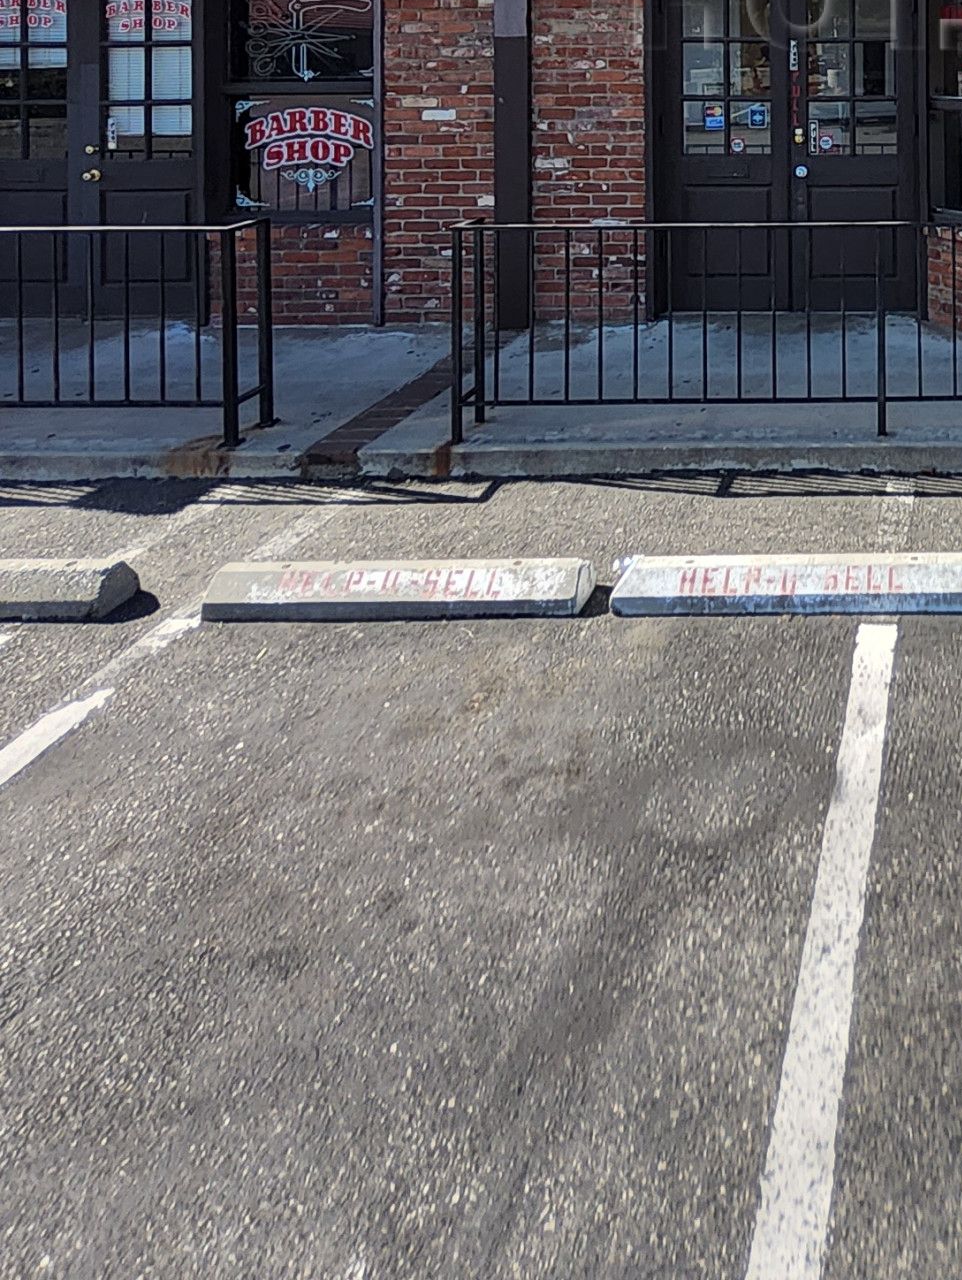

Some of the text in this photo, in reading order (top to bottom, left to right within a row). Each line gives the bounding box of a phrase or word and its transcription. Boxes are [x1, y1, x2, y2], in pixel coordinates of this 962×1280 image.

[106, 0, 191, 19] BARBER
[119, 19, 177, 33] SHOP
[245, 108, 374, 149] BARBER
[263, 141, 353, 169] SHOP
